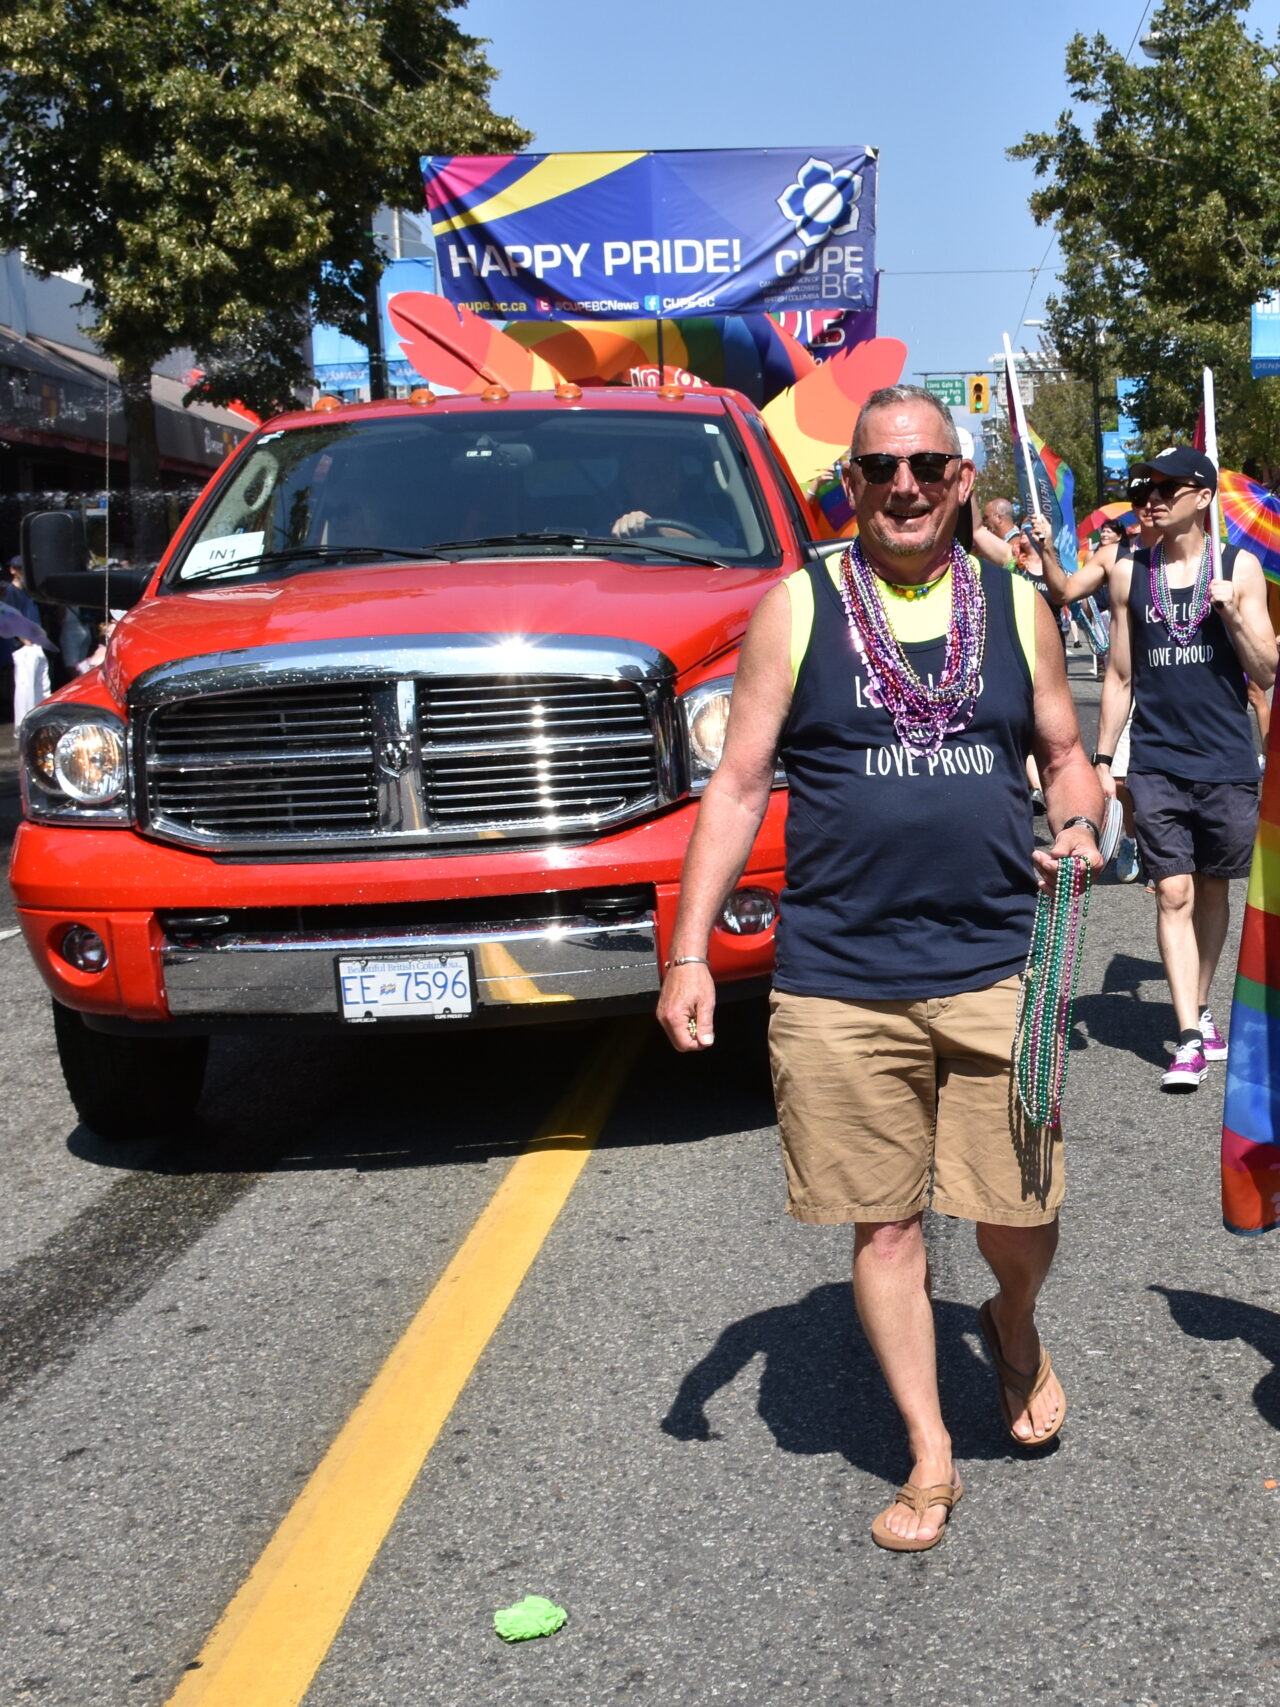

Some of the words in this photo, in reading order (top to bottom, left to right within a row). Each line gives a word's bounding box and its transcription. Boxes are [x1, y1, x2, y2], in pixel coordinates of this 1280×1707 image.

[449, 242, 590, 278] HAPPY
[603, 239, 741, 276] PRIDE!
[775, 246, 864, 277] CUPE
[822, 273, 863, 299] BC
[1148, 647, 1172, 667] LOVE
[1175, 645, 1213, 666] PROUD
[866, 744, 920, 776] LOVE
[926, 744, 995, 776] PROUD
[347, 964, 386, 974] Beautiful
[387, 961, 415, 972] British
[341, 975, 379, 1005] EE
[396, 969, 467, 1001] 7596
